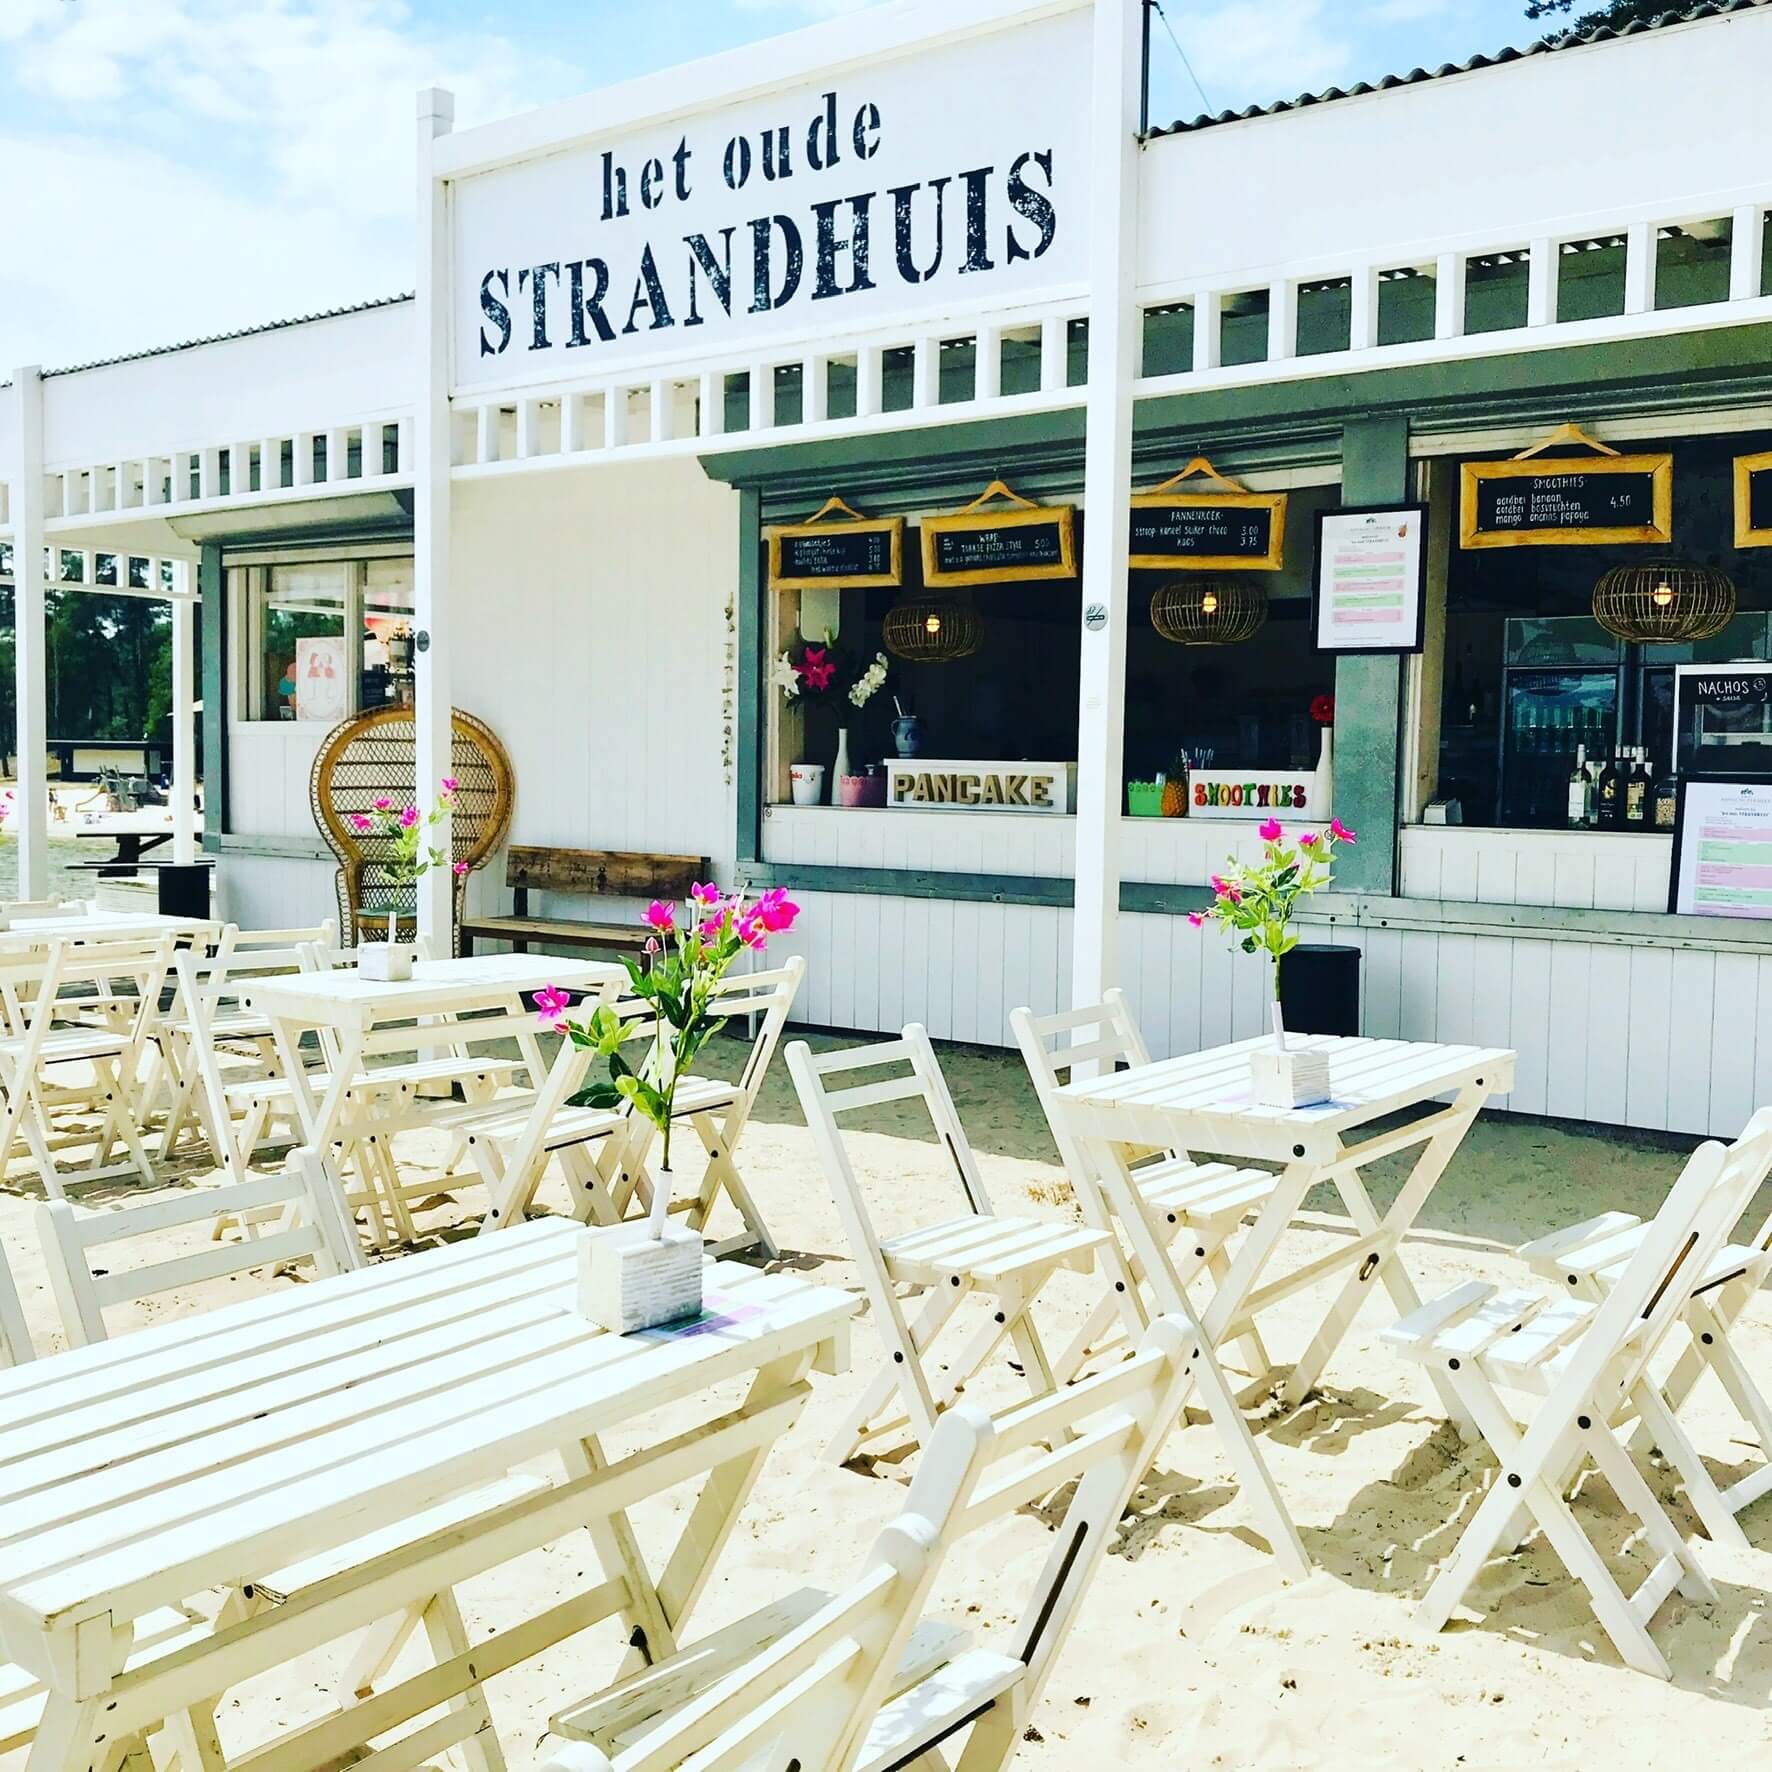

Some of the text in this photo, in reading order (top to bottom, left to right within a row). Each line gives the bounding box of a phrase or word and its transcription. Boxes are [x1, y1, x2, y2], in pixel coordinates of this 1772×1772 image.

[600, 92, 882, 221] het oude
[480, 149, 1057, 359] STRANDHUIS
[1533, 476, 1584, 489] SMOOTHIES
[1496, 493, 1562, 506] aardbei banaan
[1610, 495, 1631, 508] 4.50
[1531, 501, 1581, 513] bosvruchten
[1171, 511, 1221, 521] PANNENKOEK
[1495, 515, 1522, 526] mango
[1560, 511, 1589, 524] papaya
[1698, 681, 1750, 695] NACHOS
[894, 773, 1054, 807] PANCAKE
[1194, 782, 1307, 808] SMOOTHIES
